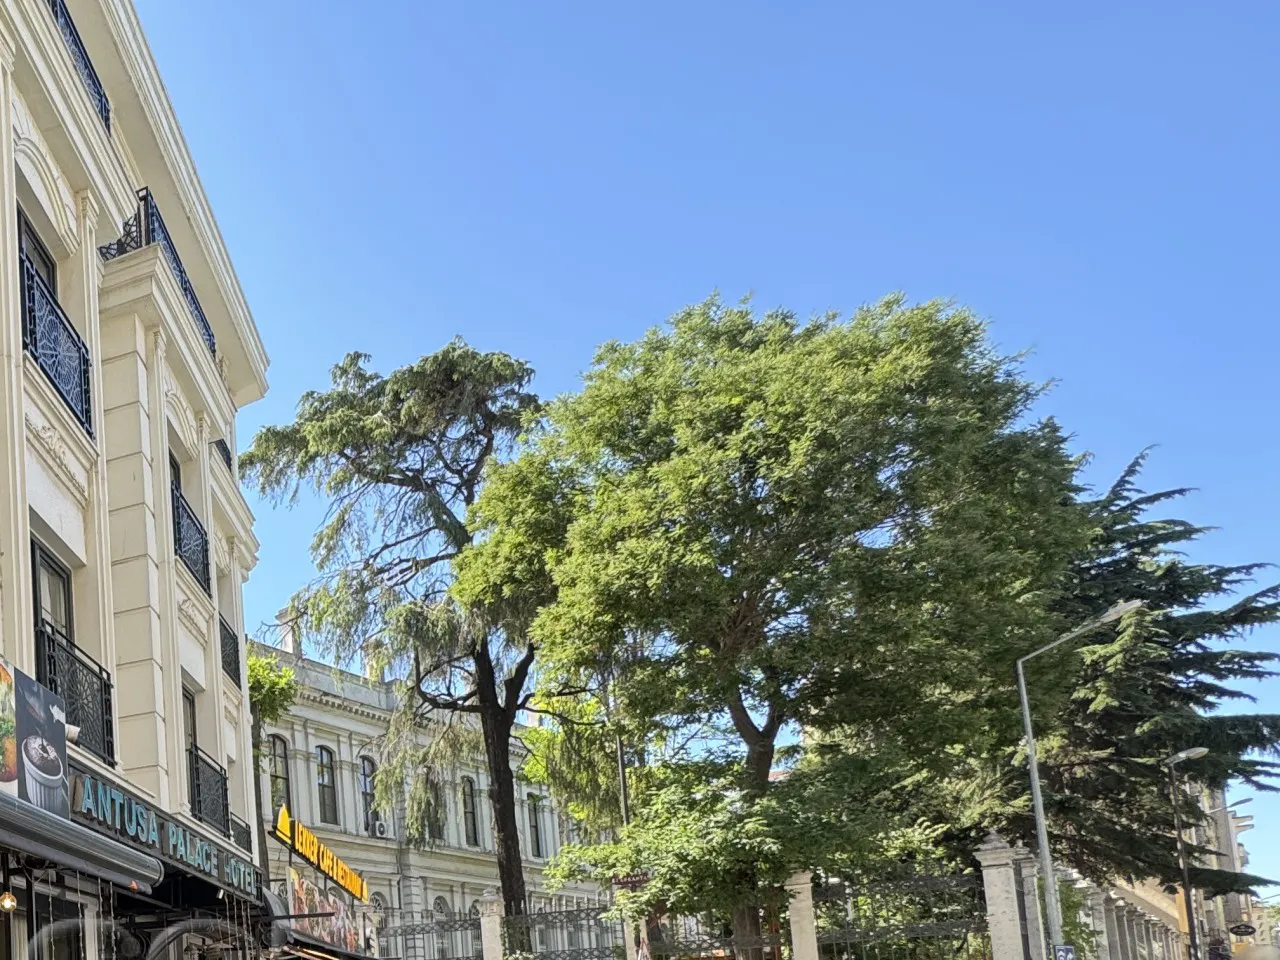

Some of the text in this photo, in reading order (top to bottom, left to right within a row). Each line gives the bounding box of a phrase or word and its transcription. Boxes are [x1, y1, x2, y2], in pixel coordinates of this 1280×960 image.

[81, 775, 258, 896] ANTUSA PALACE HOTEL
[295, 821, 318, 865] LEKKER
[319, 843, 333, 877] CAFE
